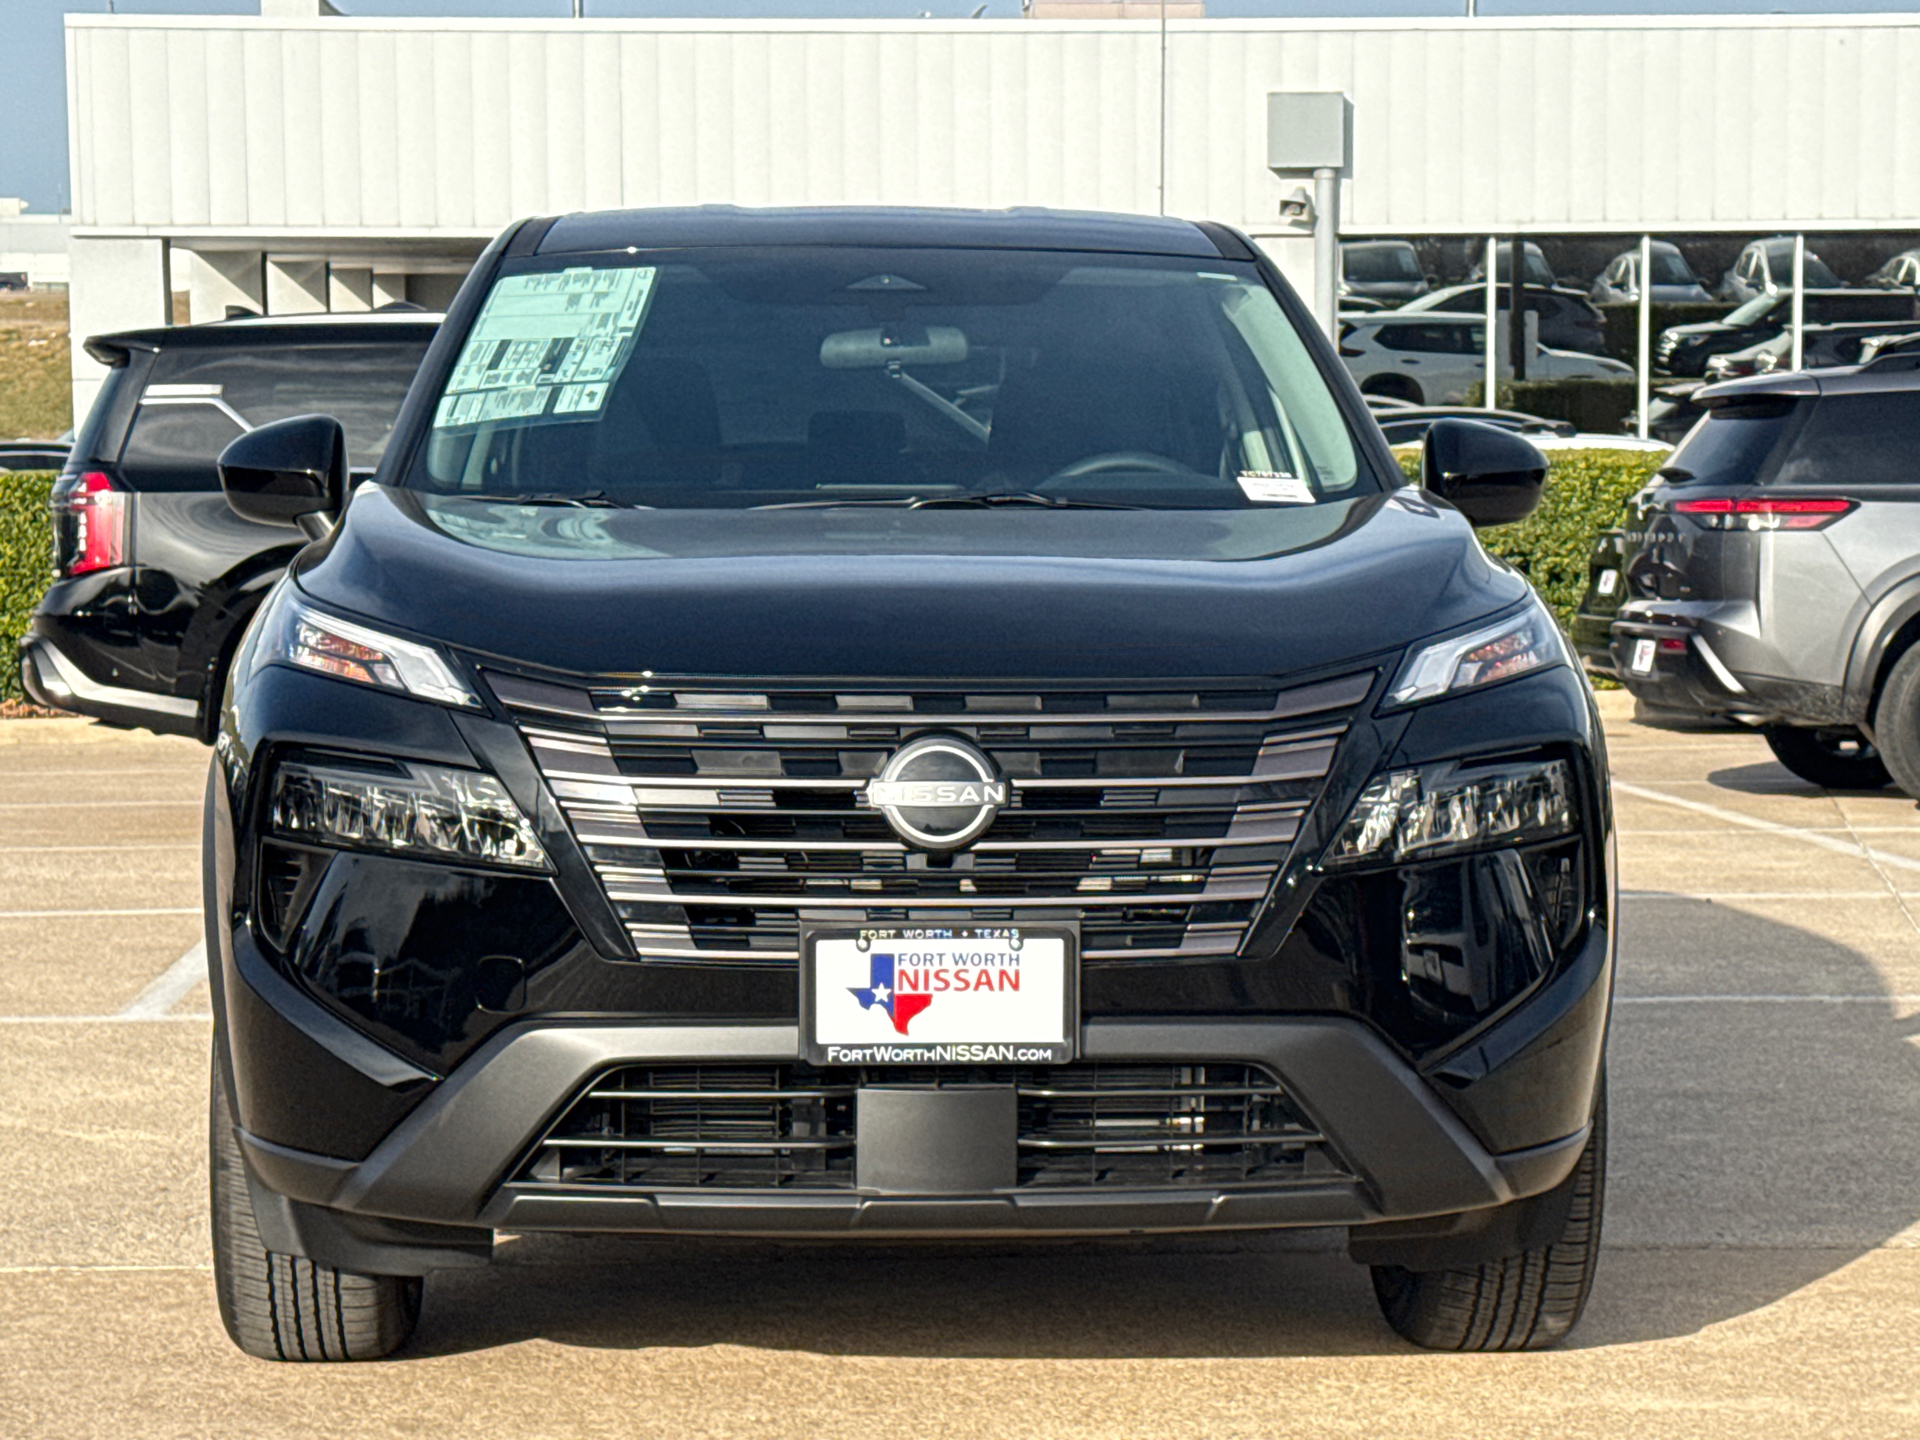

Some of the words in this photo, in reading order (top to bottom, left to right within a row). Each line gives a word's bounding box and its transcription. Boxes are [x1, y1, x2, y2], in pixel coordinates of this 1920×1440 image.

[877, 785, 1004, 803] NISSAN
[859, 930, 896, 939] FORT
[903, 929, 953, 939] WORTH
[975, 929, 1020, 939] TEXAS
[898, 953, 946, 967] FORT
[952, 953, 1020, 967] WORTH
[898, 969, 1020, 992] NISSAN
